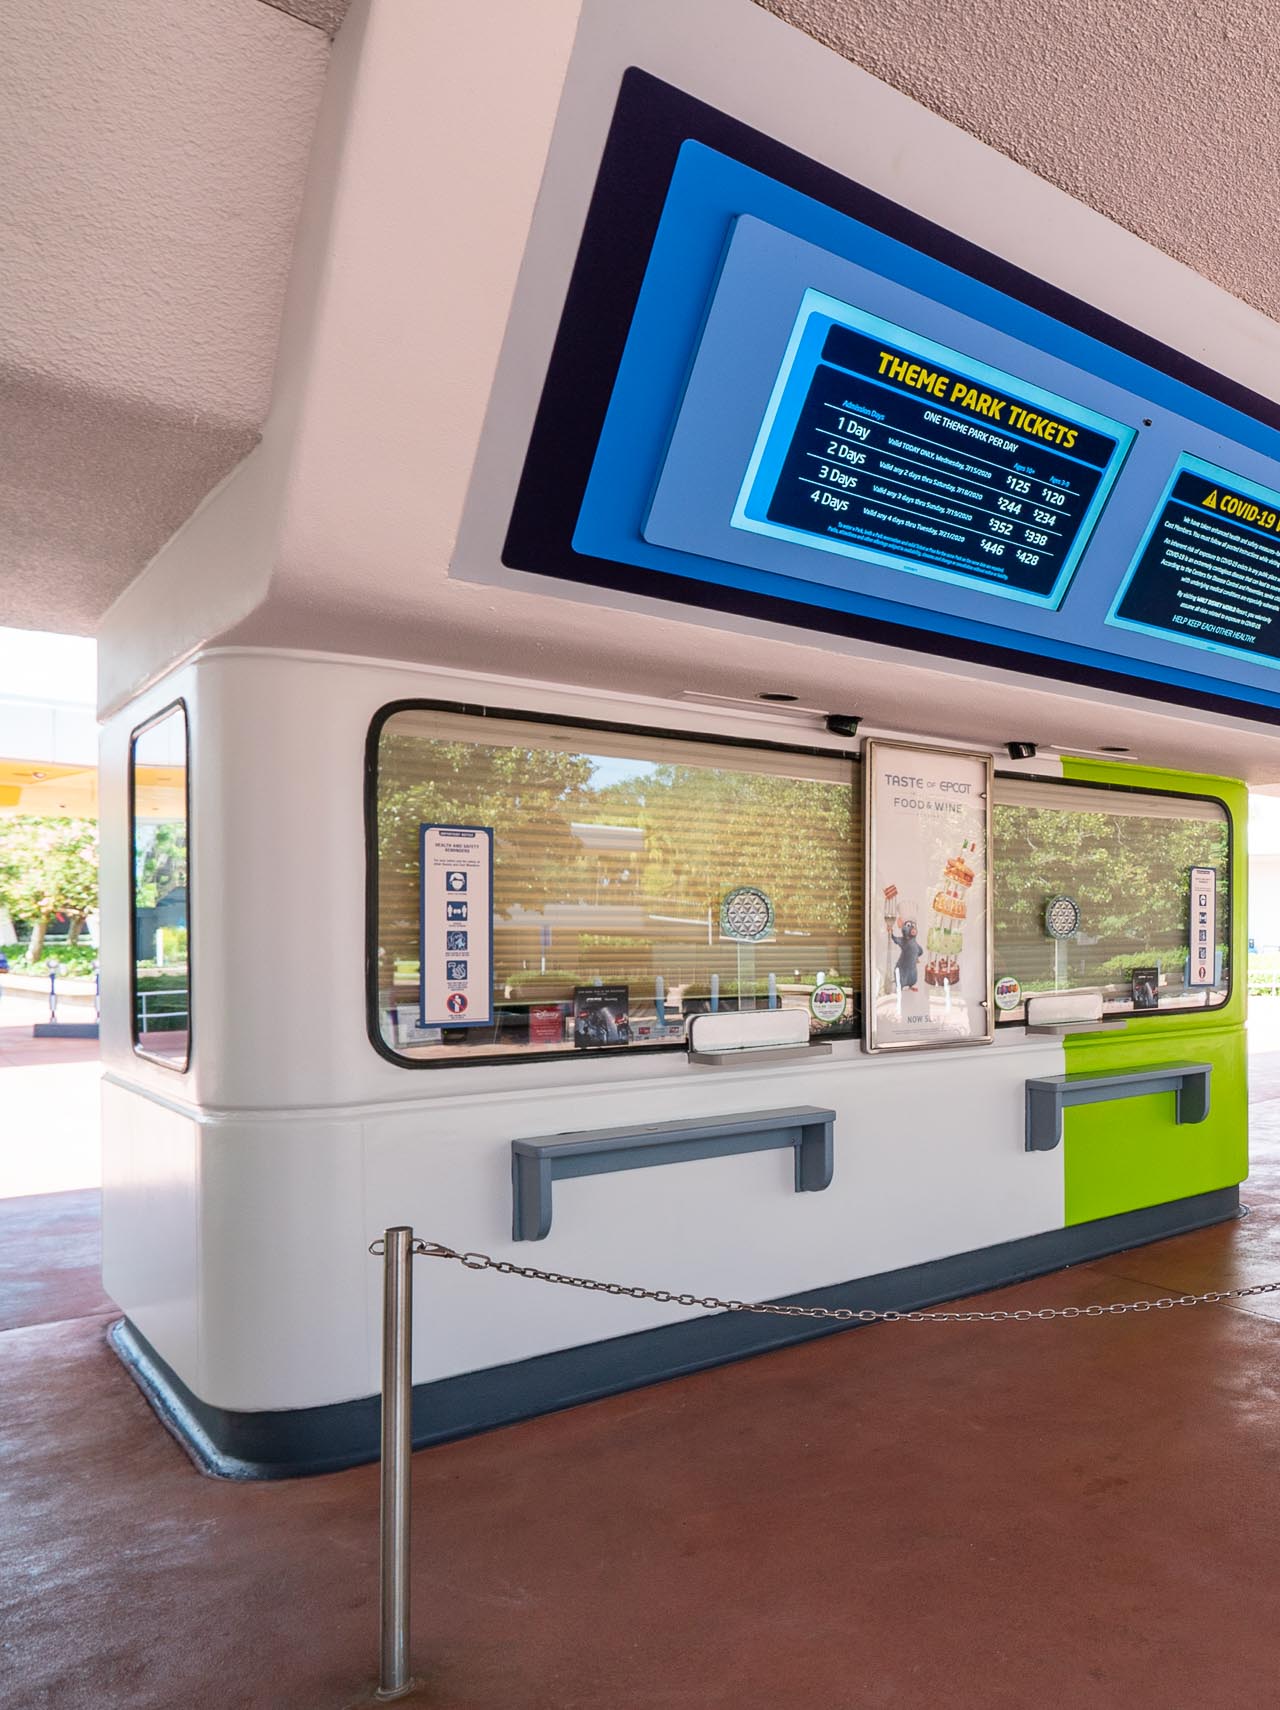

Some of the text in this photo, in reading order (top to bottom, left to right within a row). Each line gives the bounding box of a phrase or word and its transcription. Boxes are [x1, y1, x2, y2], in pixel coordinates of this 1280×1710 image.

[878, 351, 1078, 448] THEME PARK TICKETS
[842, 400, 885, 421] Admission Days
[838, 417, 871, 441] 1 Day
[923, 410, 1019, 453] ONE THEME PARK PER DAY
[827, 441, 867, 465] 2 Days
[888, 437, 992, 479] Valid TODAY ONLY, Wednesday, 7/15/2020
[818, 465, 858, 488] 3 Days
[879, 461, 894, 471] Valid
[892, 466, 904, 476] any
[908, 471, 922, 480] days
[921, 475, 933, 484] thru
[932, 479, 956, 493] Saturday,
[955, 486, 983, 500] 7/18/2020
[1006, 475, 1031, 494] $125
[810, 490, 850, 511] 4 Days
[873, 485, 887, 495] Valid
[886, 490, 898, 499] any
[901, 494, 915, 504] days
[914, 498, 927, 507] thru
[925, 501, 946, 514] Sunday,
[945, 508, 973, 521] 7/19/2020
[997, 496, 1022, 515] $244
[1041, 488, 1065, 506] $120
[1033, 508, 1057, 526] $234
[1220, 495, 1276, 528] COVID-19
[863, 507, 878, 517] Valid
[876, 512, 888, 521] any
[891, 516, 905, 525] days
[904, 520, 917, 529] thru
[916, 523, 938, 536] Tuesday,
[938, 529, 965, 543] 7/21/2020
[988, 518, 1013, 536] $352
[980, 538, 1005, 556] $446
[1024, 529, 1048, 546] $338
[1015, 549, 1040, 566] $428
[1172, 614, 1188, 624] HELP
[1186, 618, 1202, 628] KEEP
[1200, 622, 1217, 632] EACH
[1215, 626, 1234, 637] OTHER
[885, 774, 924, 789] TASTE
[940, 781, 972, 794] EPCOT
[894, 797, 963, 813] FOOD & WINE
[907, 1015, 921, 1024] NOW
